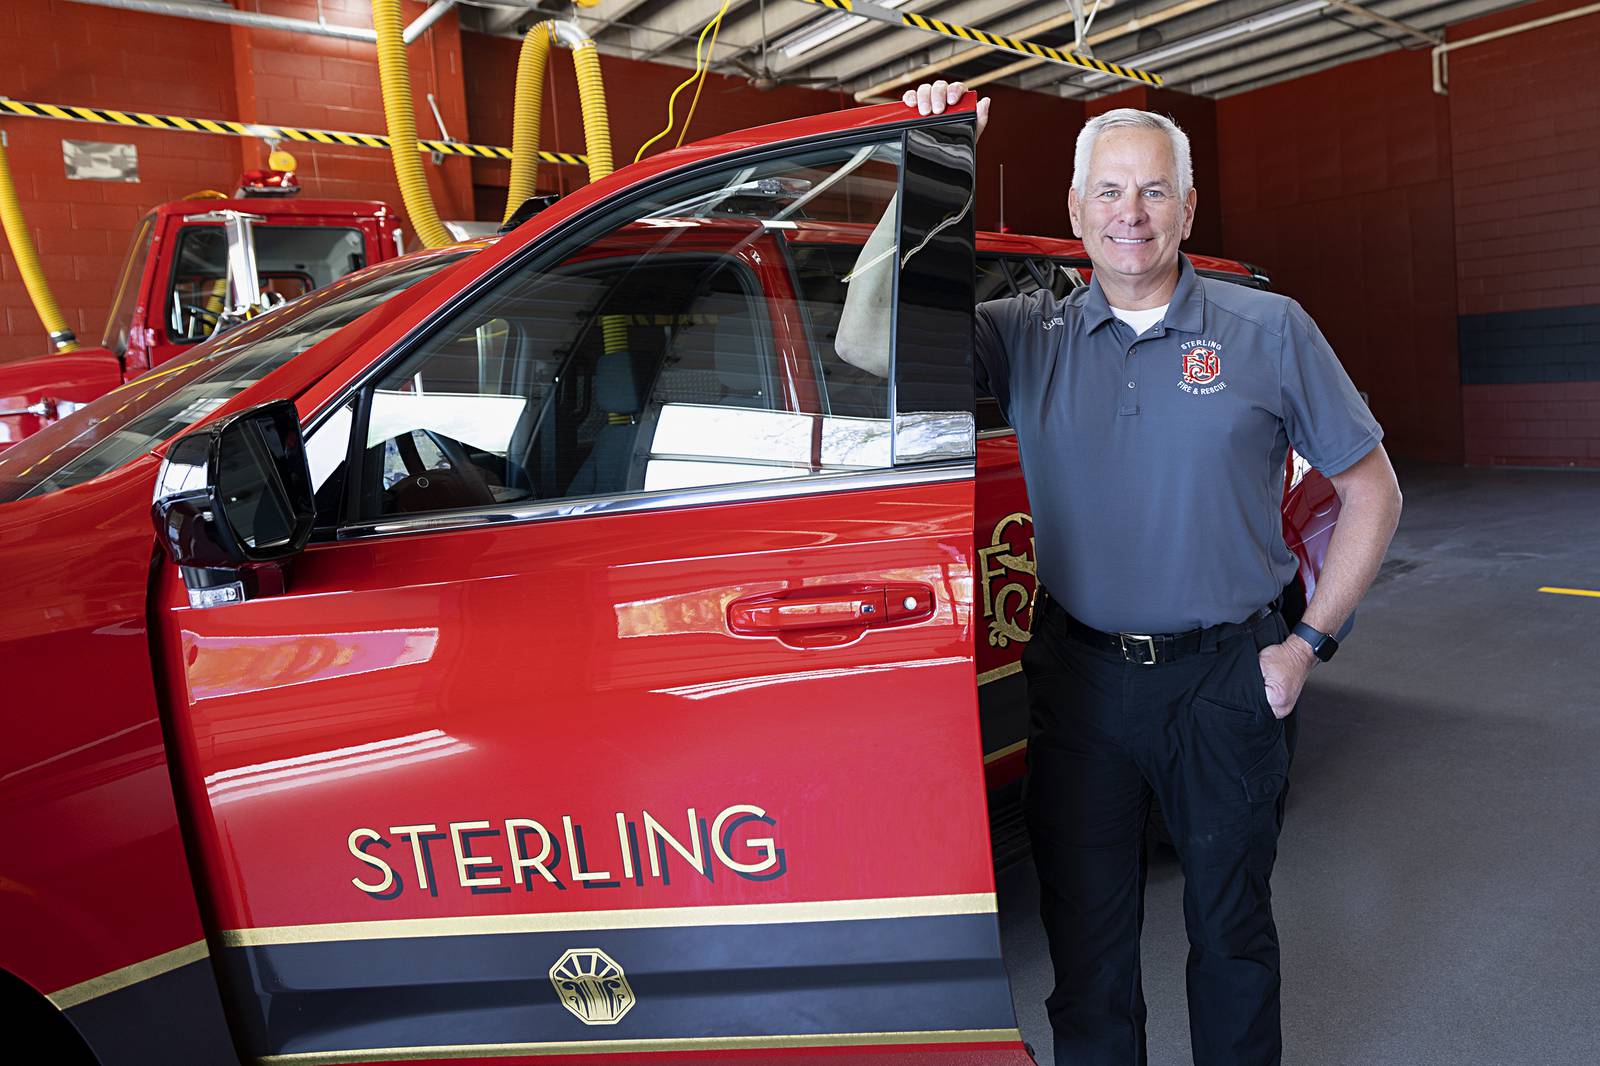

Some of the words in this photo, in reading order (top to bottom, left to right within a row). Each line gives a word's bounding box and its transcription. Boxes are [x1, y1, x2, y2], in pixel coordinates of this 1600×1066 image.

[1181, 339, 1222, 350] STERLING
[1177, 381, 1193, 393] FIRE
[1192, 387, 1199, 395] &
[1200, 382, 1228, 395] RESCUE
[347, 804, 780, 895] STERLING
